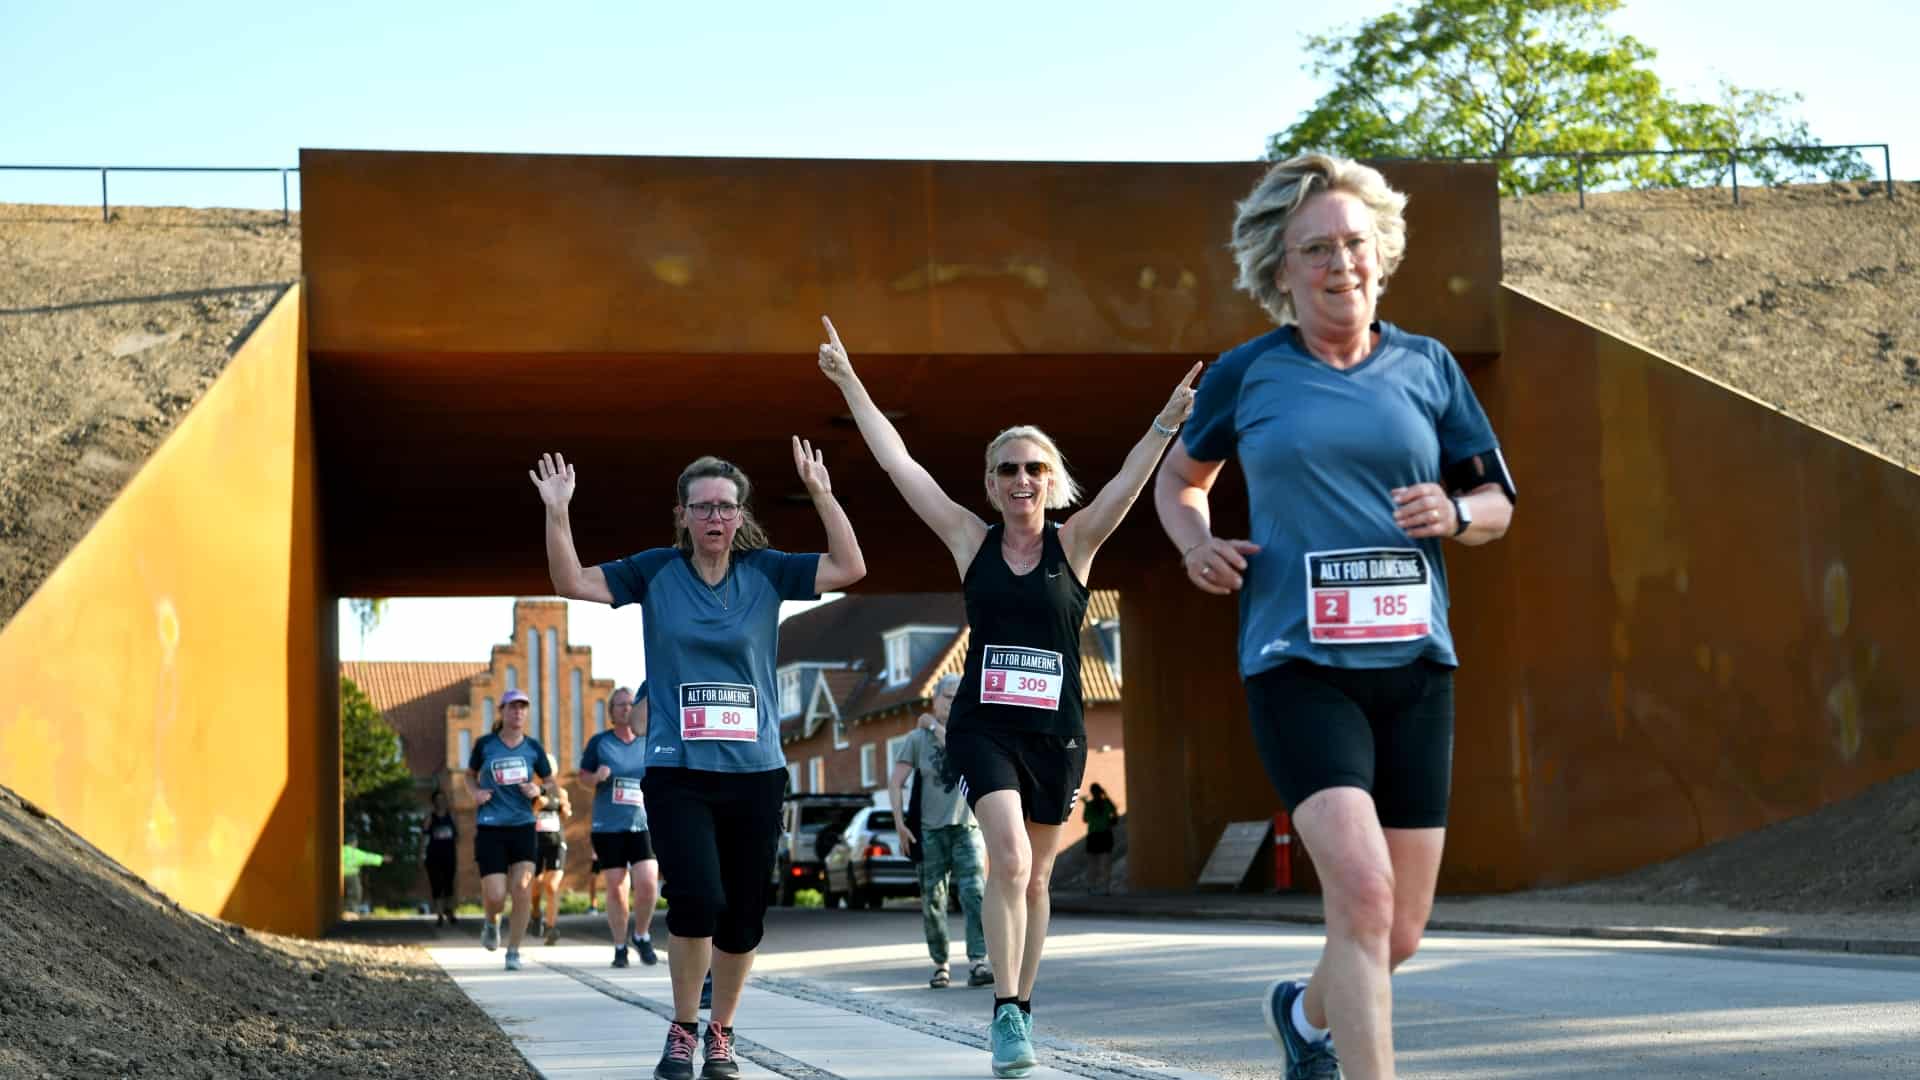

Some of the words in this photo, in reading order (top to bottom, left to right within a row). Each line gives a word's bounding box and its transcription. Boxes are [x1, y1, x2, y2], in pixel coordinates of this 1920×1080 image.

[1320, 562, 1341, 580] ALT
[1343, 560, 1368, 580] FOR
[1324, 597, 1339, 617] 2
[1373, 594, 1408, 617] 185
[991, 653, 1006, 665] ALT
[1005, 653, 1020, 666] FOR
[1021, 654, 1057, 671] DAMERNE
[991, 675, 999, 687] 3
[1017, 676, 1048, 692] 309
[687, 689, 701, 702] ALT
[702, 688, 717, 702] FOR
[718, 690, 751, 703] DAMERNE
[691, 712, 698, 724] 1
[721, 711, 741, 725] 80
